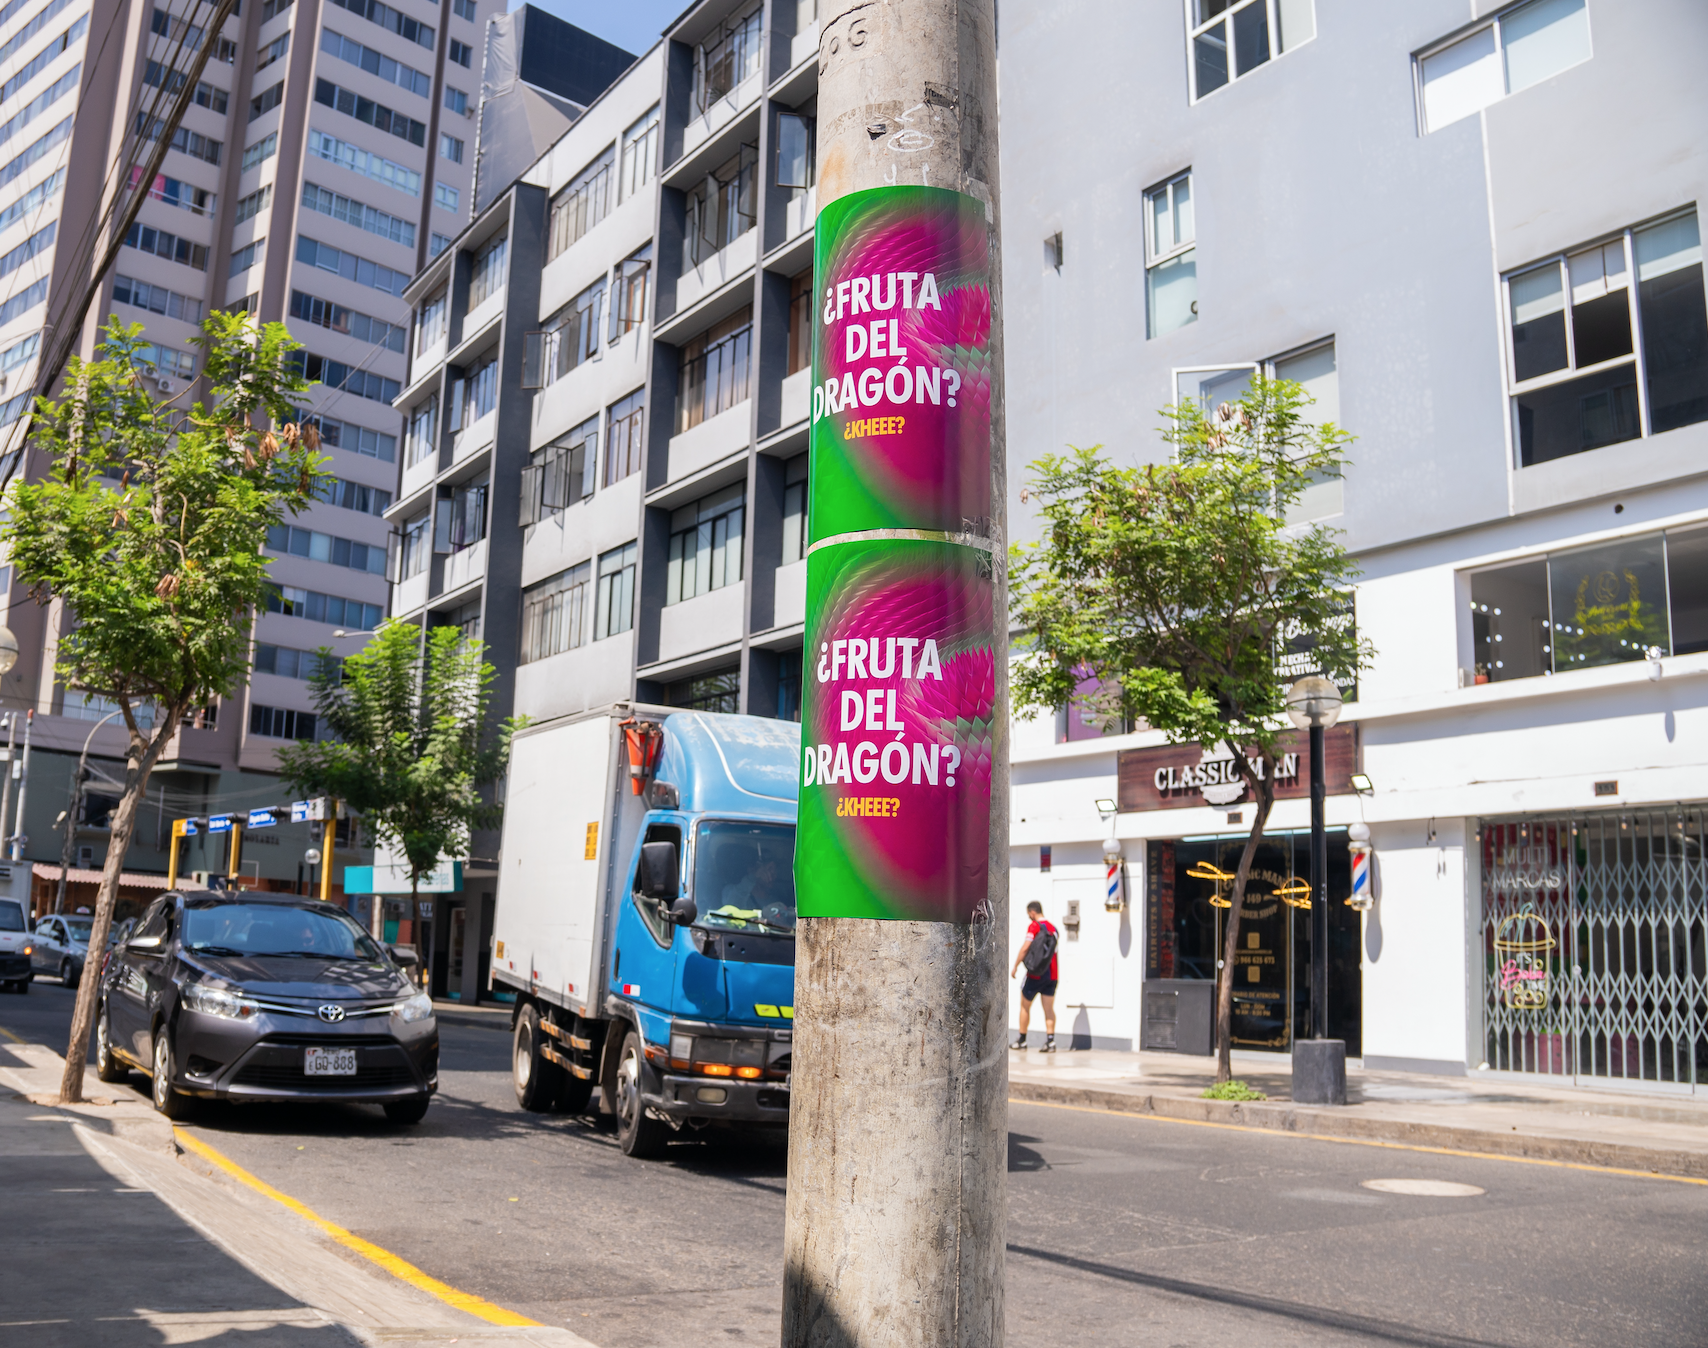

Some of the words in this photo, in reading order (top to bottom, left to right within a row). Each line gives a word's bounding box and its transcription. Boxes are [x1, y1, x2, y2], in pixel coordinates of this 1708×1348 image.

[824, 272, 942, 326] ¿FRUTA
[845, 318, 907, 364] DEL
[812, 354, 961, 425] DRAGÓN?
[843, 415, 906, 441] ¿KHEEE?
[817, 636, 943, 684] ¿FRUTA
[840, 688, 905, 732] DEL
[803, 730, 962, 788] DRAGÓN?
[1154, 760, 1240, 790] CLASSIC
[835, 796, 901, 818] ¿KHEEE?
[1503, 846, 1549, 865] MULTI
[1493, 870, 1562, 889] MARCAS
[1150, 907, 1158, 969] HAIRCUTS
